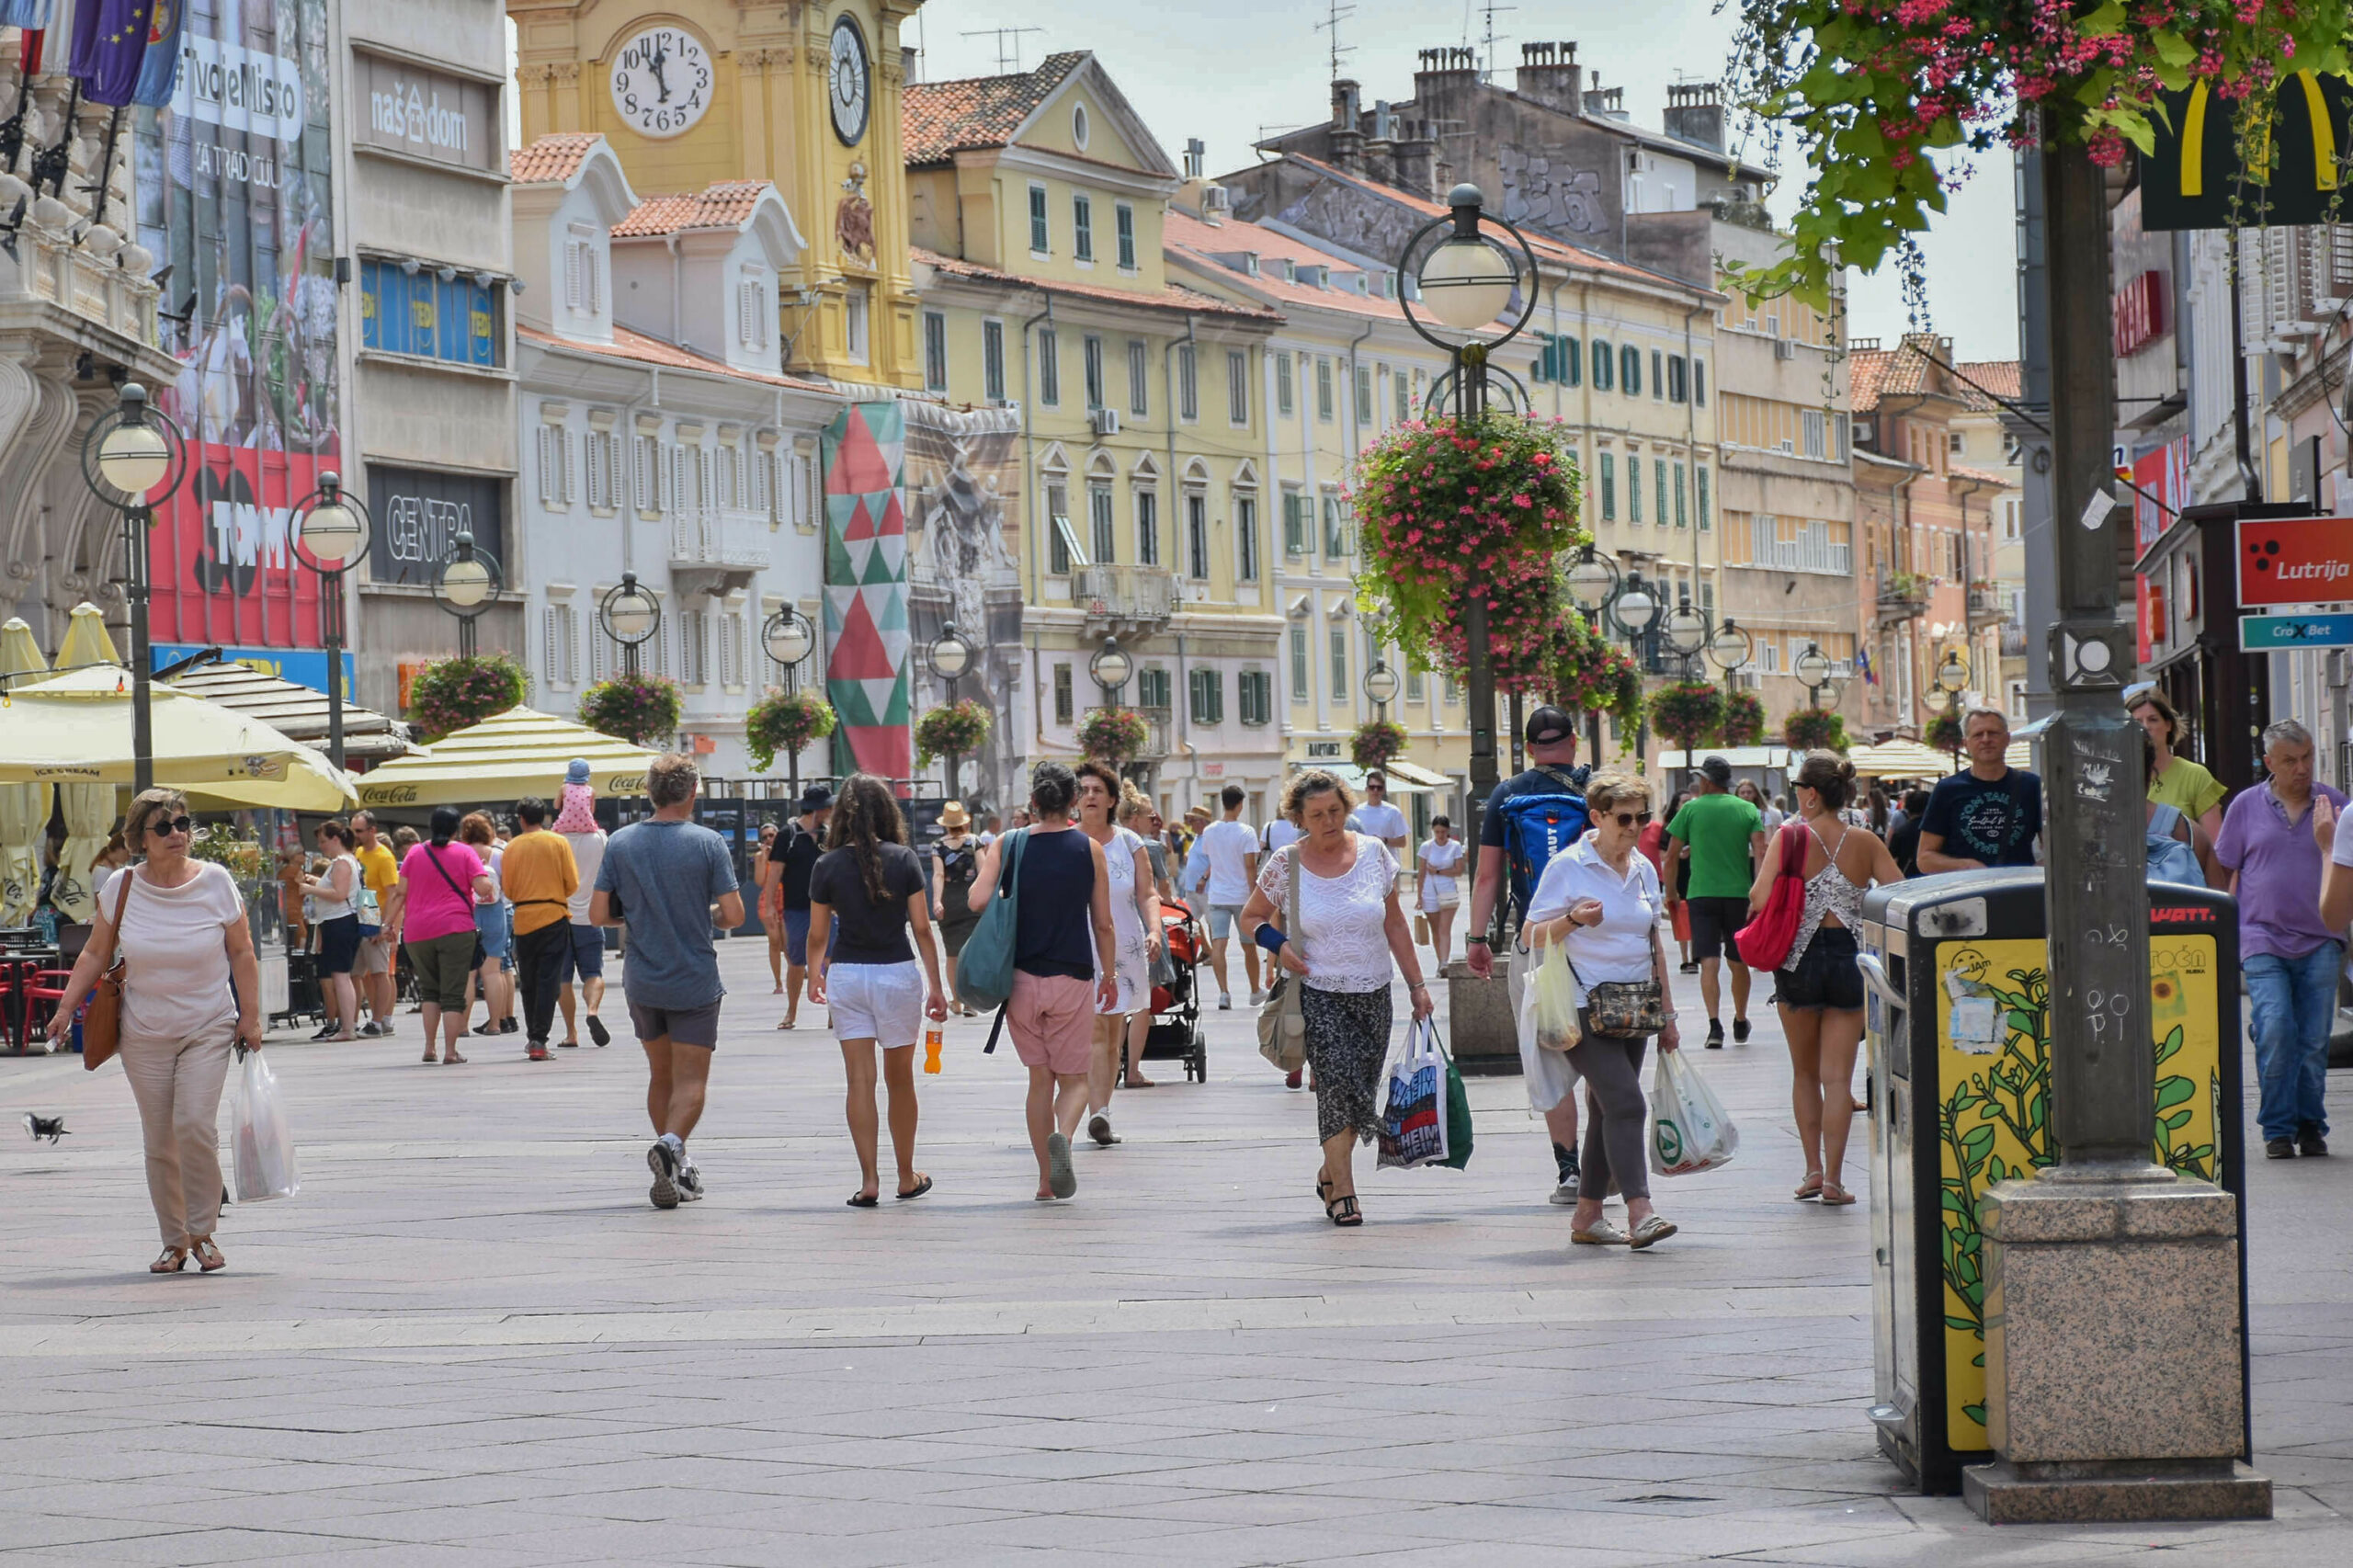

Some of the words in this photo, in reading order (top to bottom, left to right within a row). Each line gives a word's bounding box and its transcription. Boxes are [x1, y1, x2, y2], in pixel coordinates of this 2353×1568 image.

[640, 37, 651, 58] 11
[655, 32, 672, 55] 12
[678, 37, 686, 57] 1
[624, 49, 640, 70] 10
[688, 47, 699, 67] 2
[617, 72, 629, 93] 9
[696, 67, 708, 89] 3
[624, 93, 638, 115] 8
[688, 89, 700, 109] 4
[371, 81, 406, 137] naš
[426, 91, 468, 152] dom
[642, 108, 654, 128] 7
[656, 109, 670, 131] 6
[674, 104, 687, 127] 5
[212, 144, 284, 189] TRADCIJU
[212, 500, 304, 572] TOMMY
[2276, 559, 2350, 582] Lutrija
[34, 768, 54, 777] ICE
[57, 767, 101, 778] CREAM
